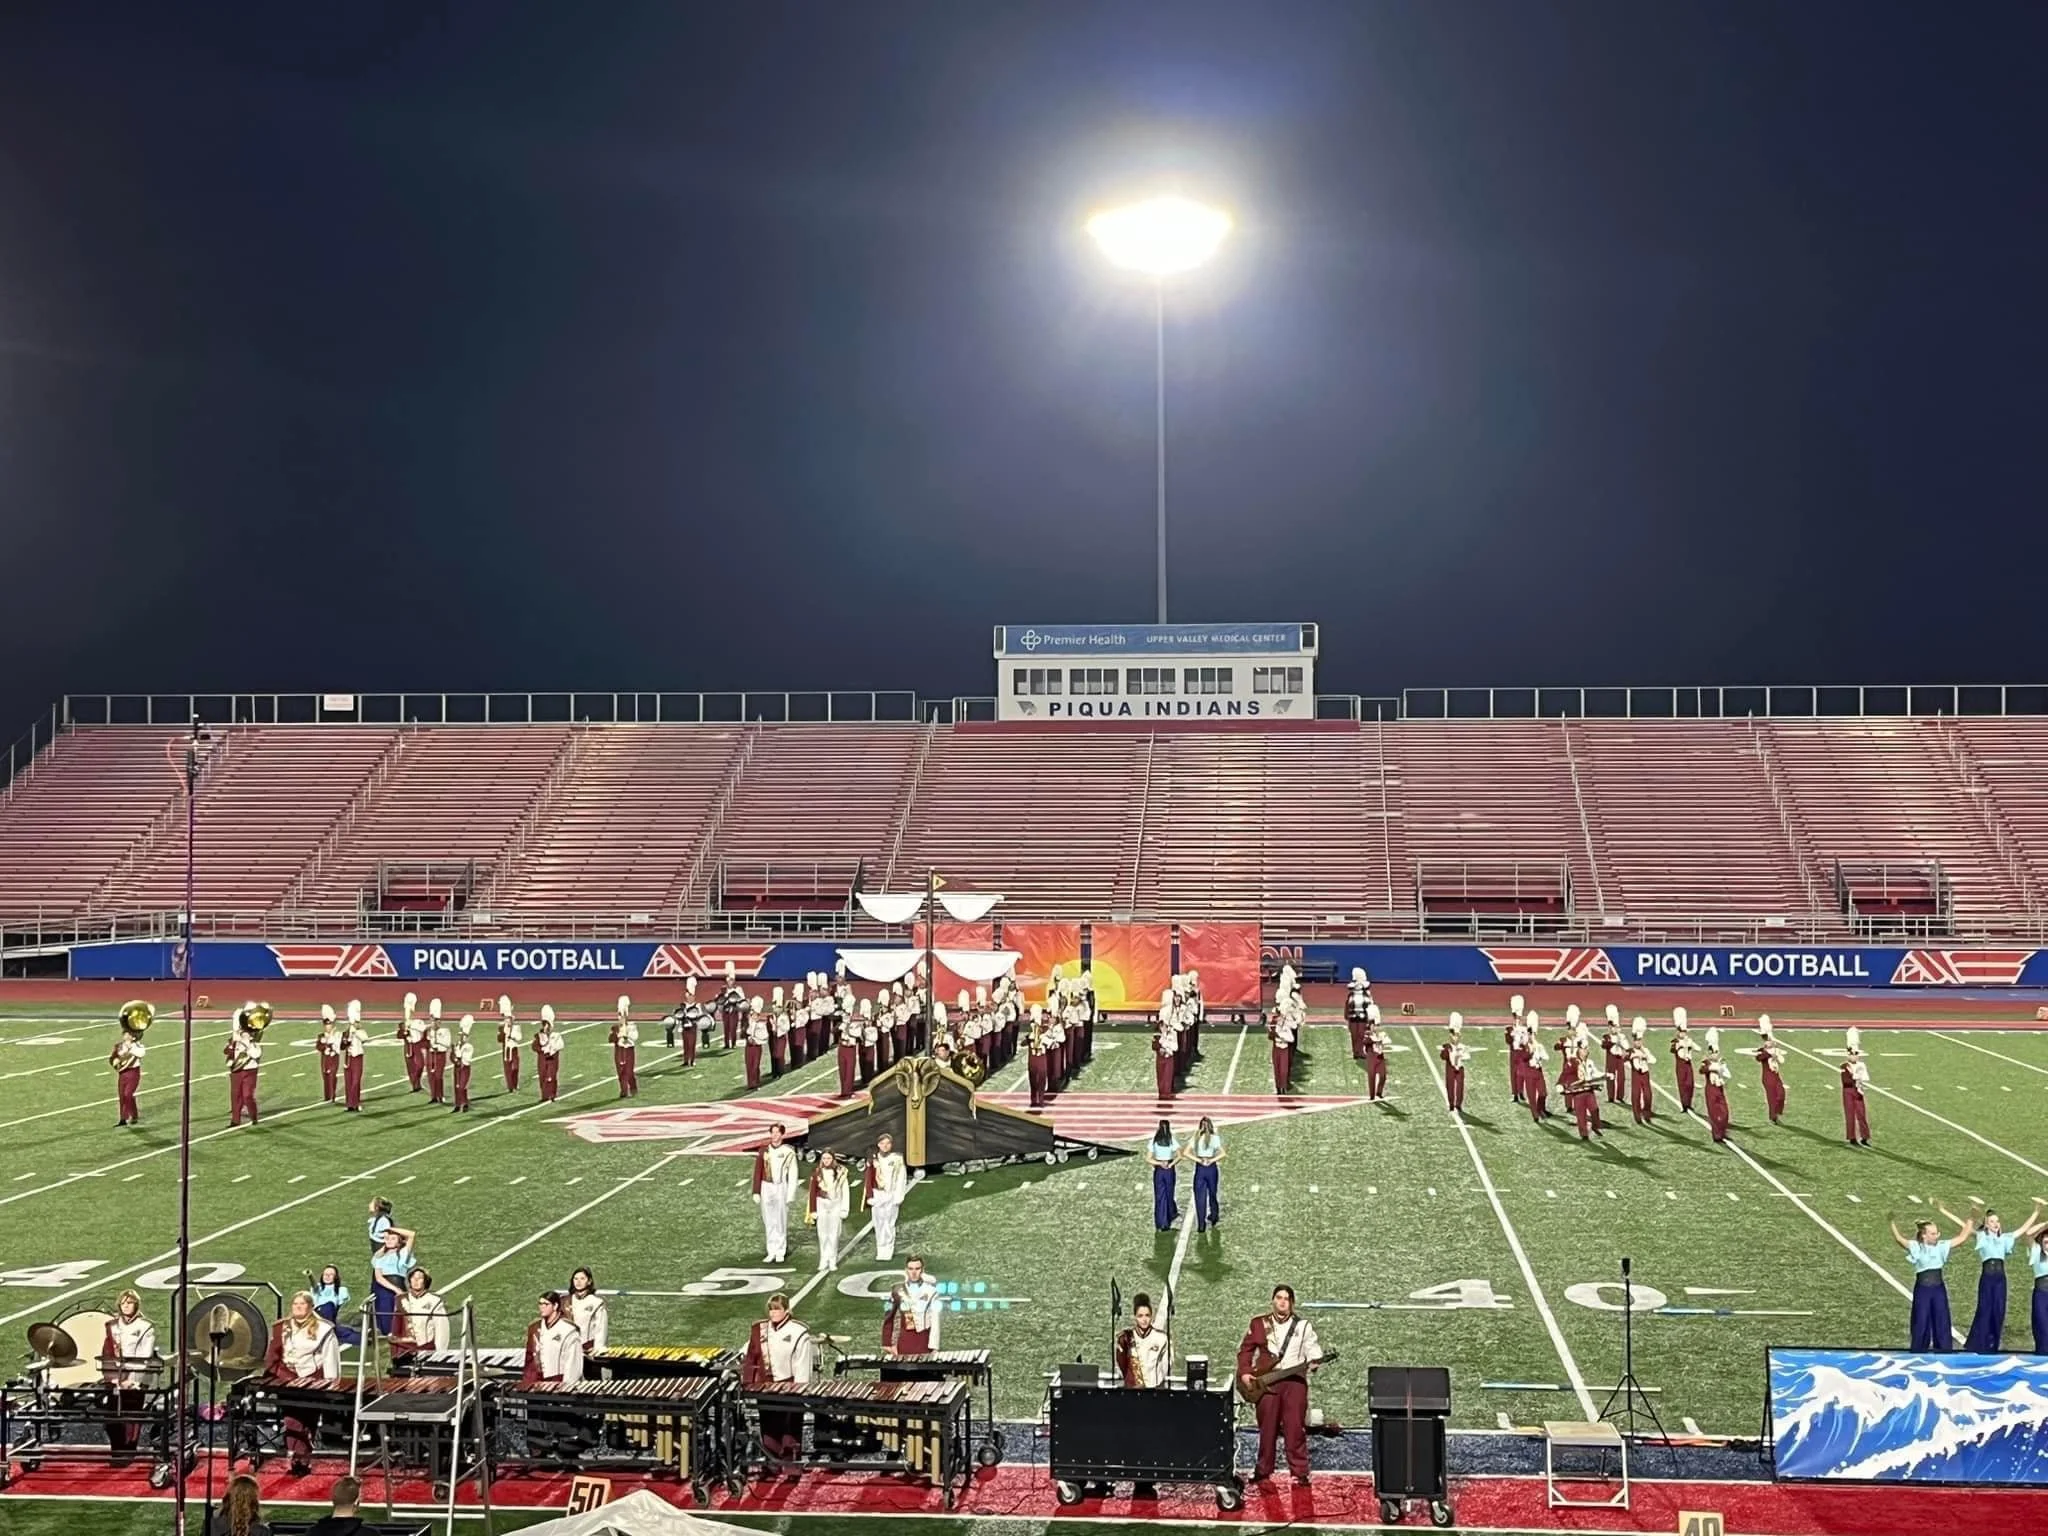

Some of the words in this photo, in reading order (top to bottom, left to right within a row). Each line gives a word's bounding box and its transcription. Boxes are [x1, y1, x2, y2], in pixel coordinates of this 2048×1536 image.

[1043, 634, 1086, 645] Premier
[1088, 634, 1126, 645] Health
[1146, 635, 1174, 644] UPPER
[1176, 634, 1208, 643] VALLEY
[1210, 634, 1250, 643] MEDICAL
[1252, 633, 1286, 643] CENTER
[1049, 701, 1133, 718] PIQUA
[1145, 700, 1261, 716] INDIANS
[413, 948, 488, 971] PIQUA
[496, 948, 625, 970] FOOTBALL
[1637, 953, 1719, 976] PIQUA
[1729, 953, 1870, 976] FOOTBALL
[1403, 1004, 1415, 1015] 40
[1721, 1006, 1733, 1017] 30
[569, 1481, 605, 1516] 50
